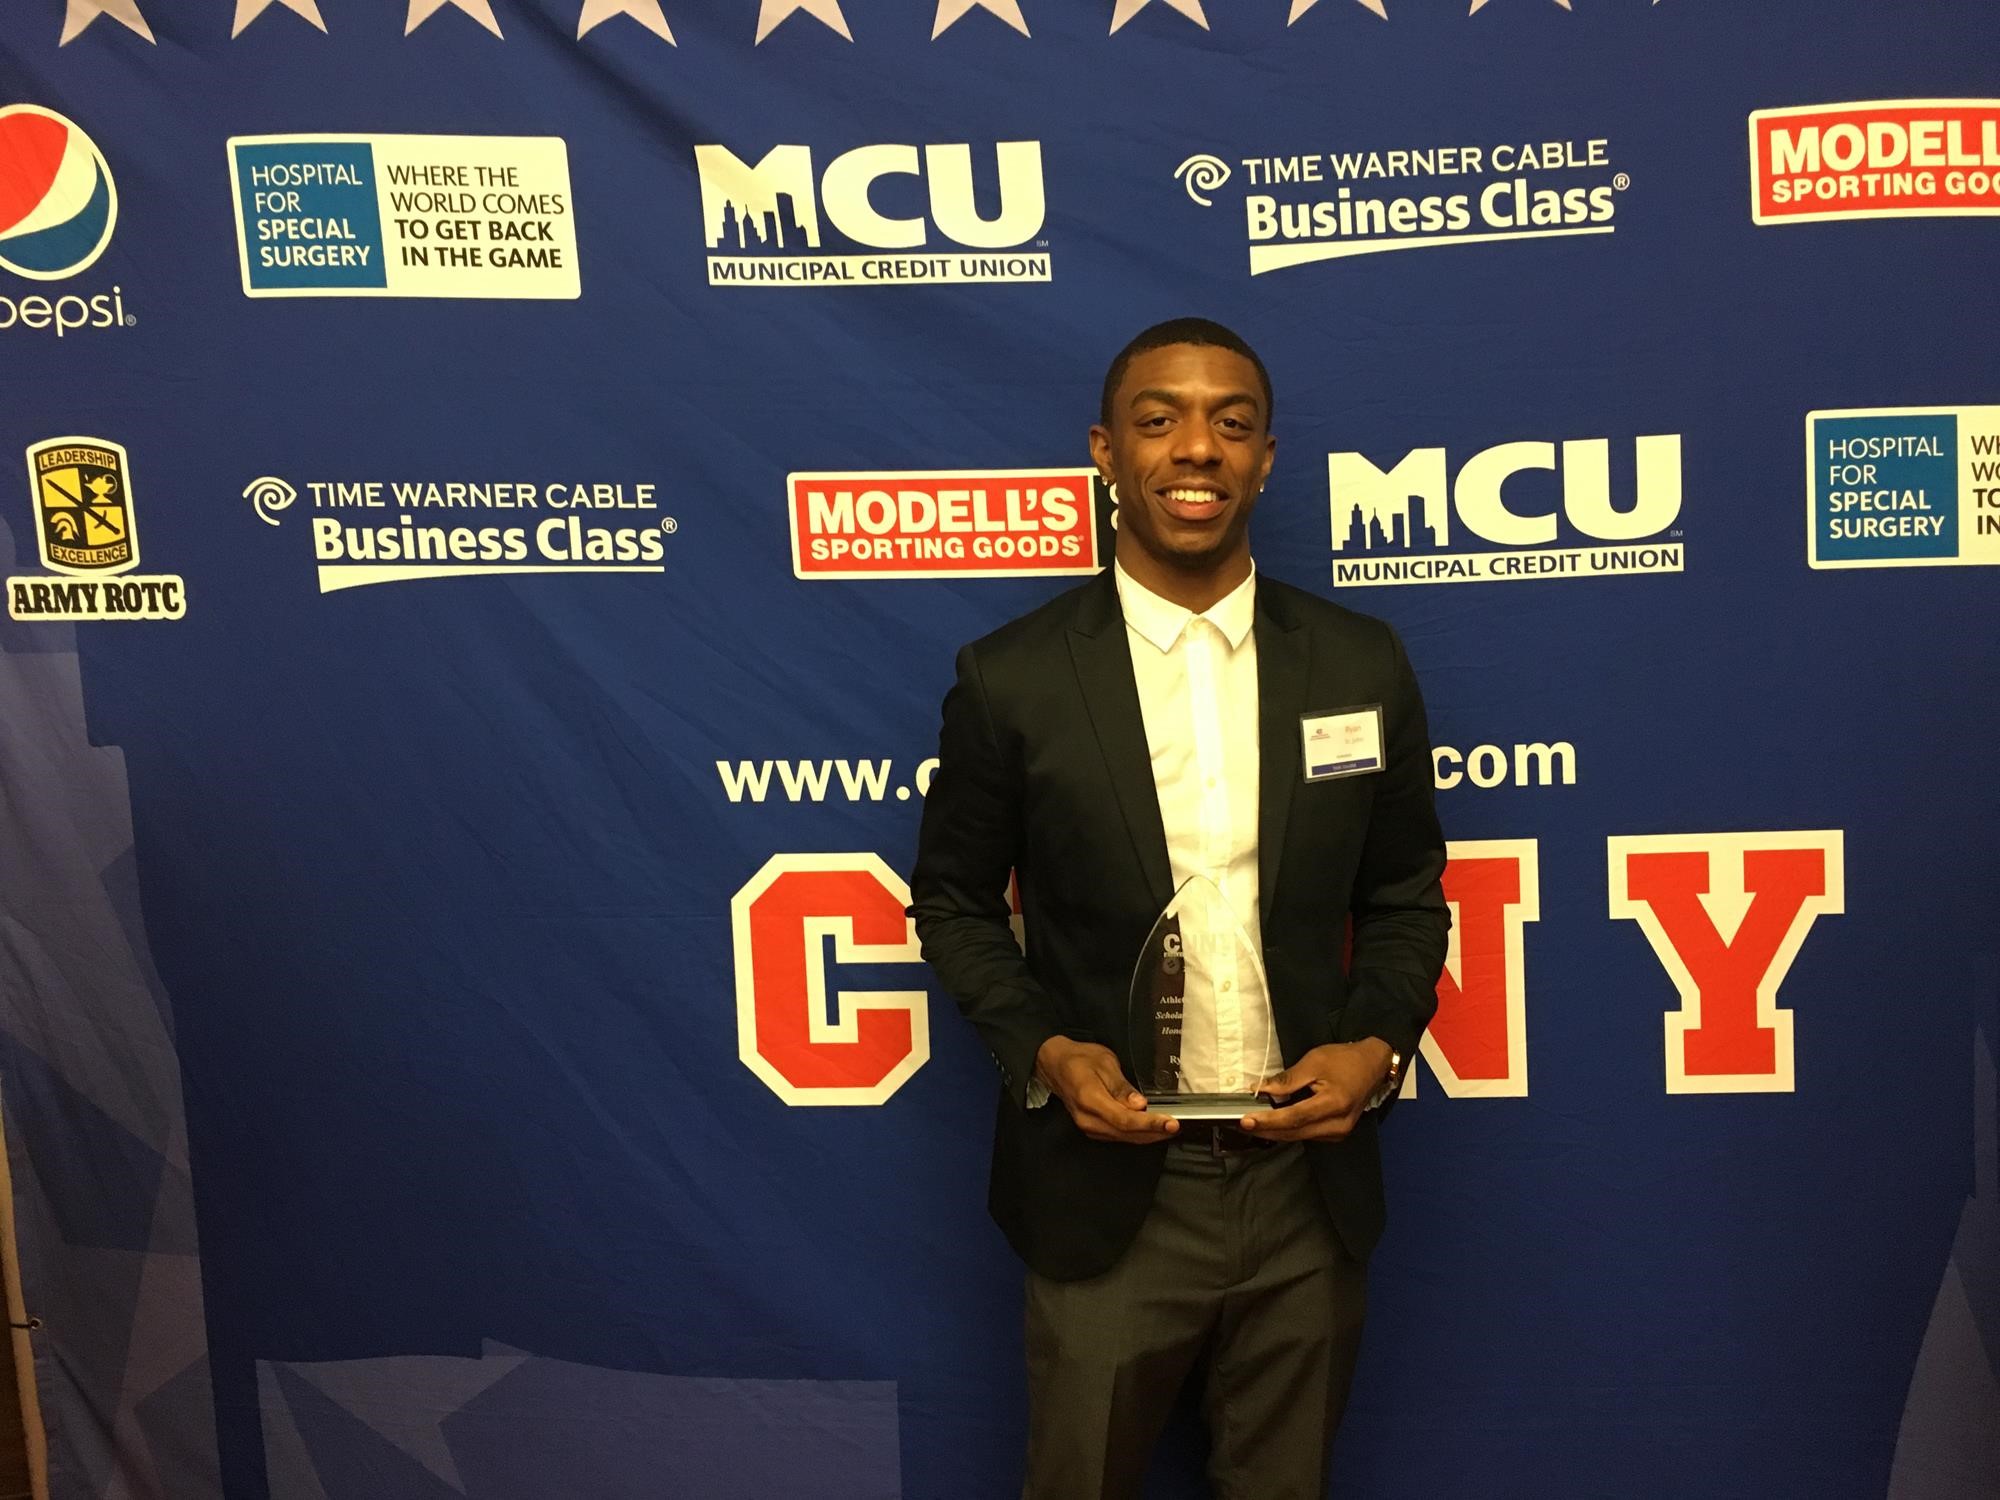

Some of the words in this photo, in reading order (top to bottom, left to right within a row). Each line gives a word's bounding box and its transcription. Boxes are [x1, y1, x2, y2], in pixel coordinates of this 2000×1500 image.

[1242, 155, 1323, 185] TIME
[1330, 146, 1483, 181] WARNER
[1491, 139, 1610, 172] CABLE
[252, 164, 363, 186] HOSPITAL
[387, 164, 469, 186] WHERE
[476, 166, 519, 187] THE
[1772, 171, 1936, 203] SPORTING
[255, 192, 302, 213] FOR
[390, 192, 476, 214] WORLD
[483, 194, 564, 215] COMES
[694, 140, 1046, 249] MCU
[1246, 187, 1470, 240] Business
[1480, 178, 1615, 228] Class
[257, 218, 356, 241] SPECIAL
[394, 219, 429, 240] TO
[435, 220, 482, 241] GET
[488, 221, 554, 242] BACK
[260, 245, 370, 267] SURGERY
[401, 246, 429, 266] IN
[435, 247, 483, 267] THE
[488, 248, 563, 268] GAME
[712, 261, 855, 281] MUNICIPAL
[861, 259, 951, 279] CREDIT
[960, 258, 1047, 277] UNION
[41, 449, 115, 468] LEADERSHIP
[1829, 436, 1944, 460] HOSPITAL
[1829, 464, 1877, 486] FOR
[307, 482, 385, 508] TIME
[391, 483, 538, 509] WARNER
[545, 484, 658, 509] CABLE
[1328, 433, 1683, 551] MCU
[1829, 489, 1931, 513] SPECIAL
[807, 487, 1079, 535] MODELL'S
[312, 515, 527, 560] Business
[536, 516, 665, 561] Class
[1829, 515, 1945, 539] SURGERY
[53, 545, 127, 563] EXCELLENCE
[811, 537, 965, 560] SPORTING
[972, 535, 1081, 558] GOODS
[1337, 559, 1482, 582] MUNICIPAL
[1489, 554, 1582, 576] CREDIT
[1590, 549, 1679, 571] UNION
[13, 583, 99, 613] ARMY
[102, 582, 180, 613] ROTC
